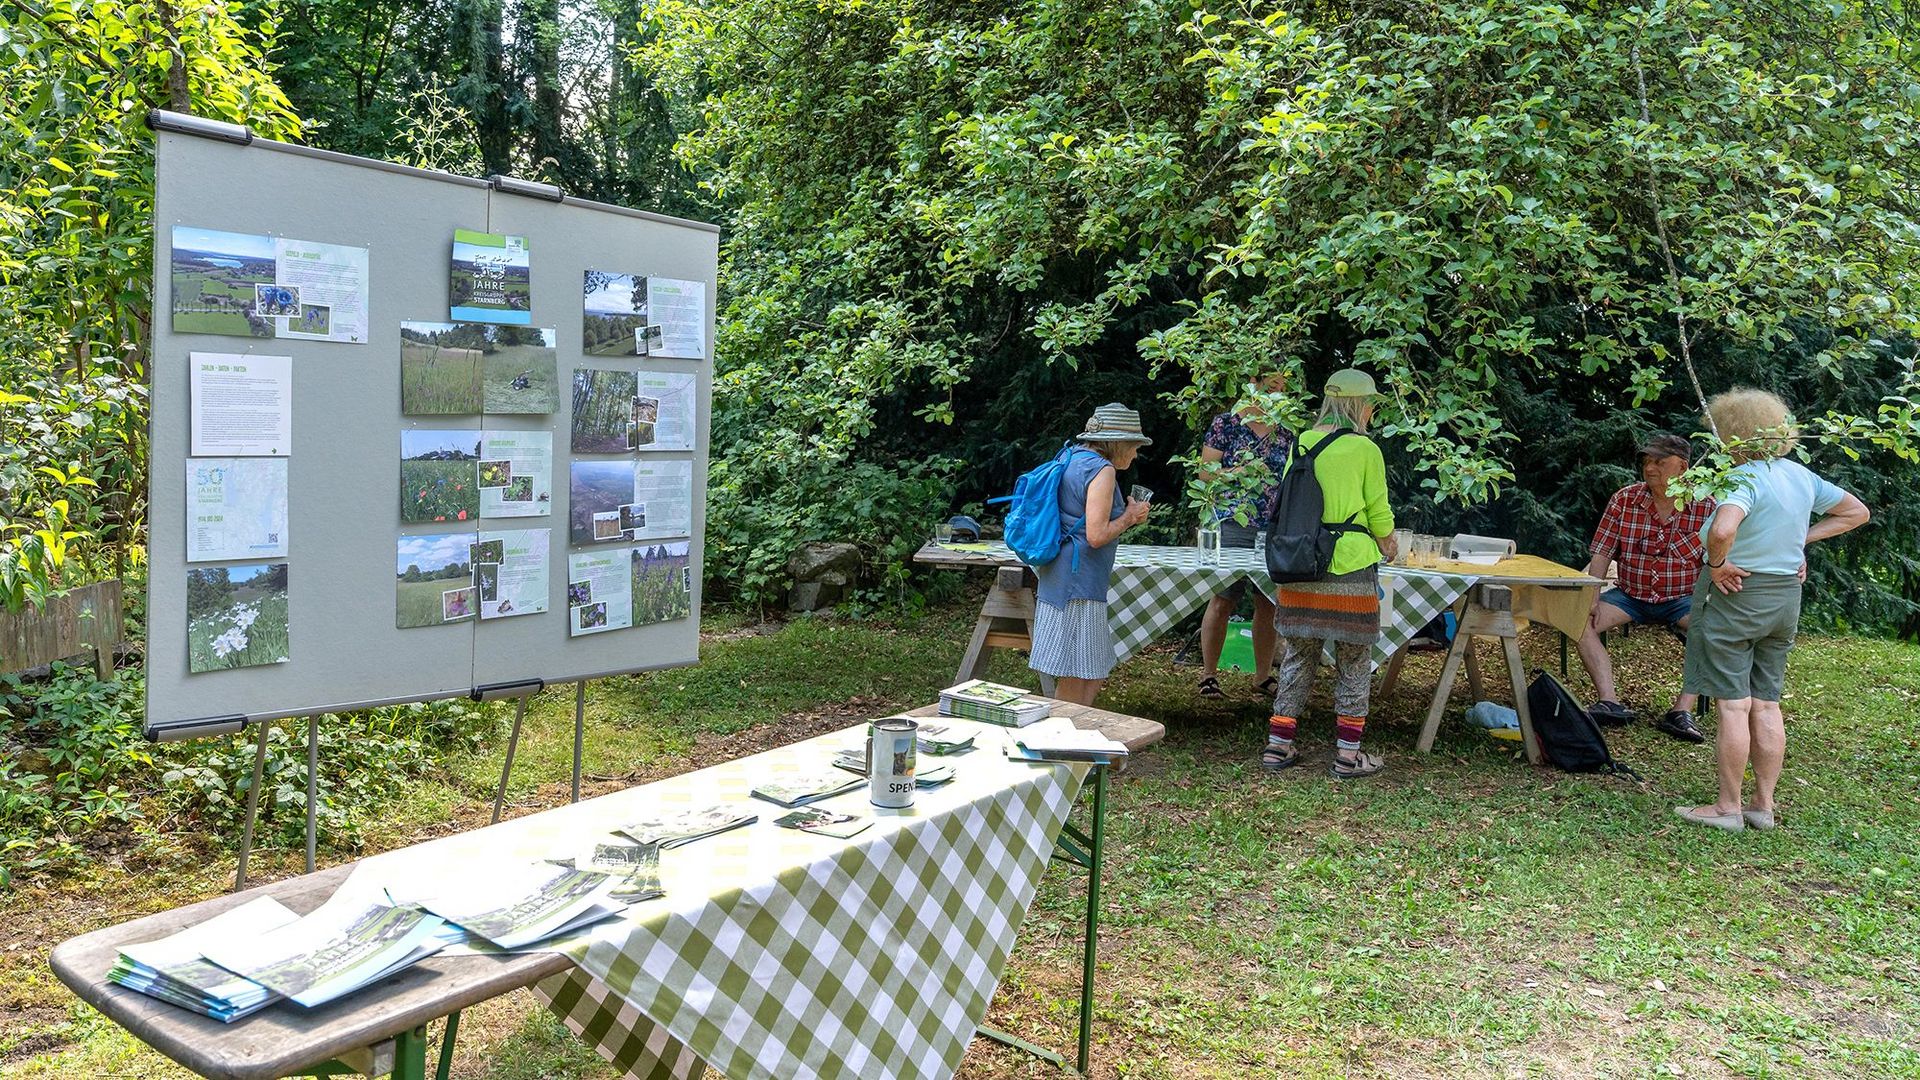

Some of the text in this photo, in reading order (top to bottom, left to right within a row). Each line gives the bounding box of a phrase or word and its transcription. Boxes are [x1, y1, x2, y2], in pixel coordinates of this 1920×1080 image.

[473, 280, 505, 290] JAHRE
[198, 486, 223, 494] JAHRE
[889, 782, 915, 793] SPEN
